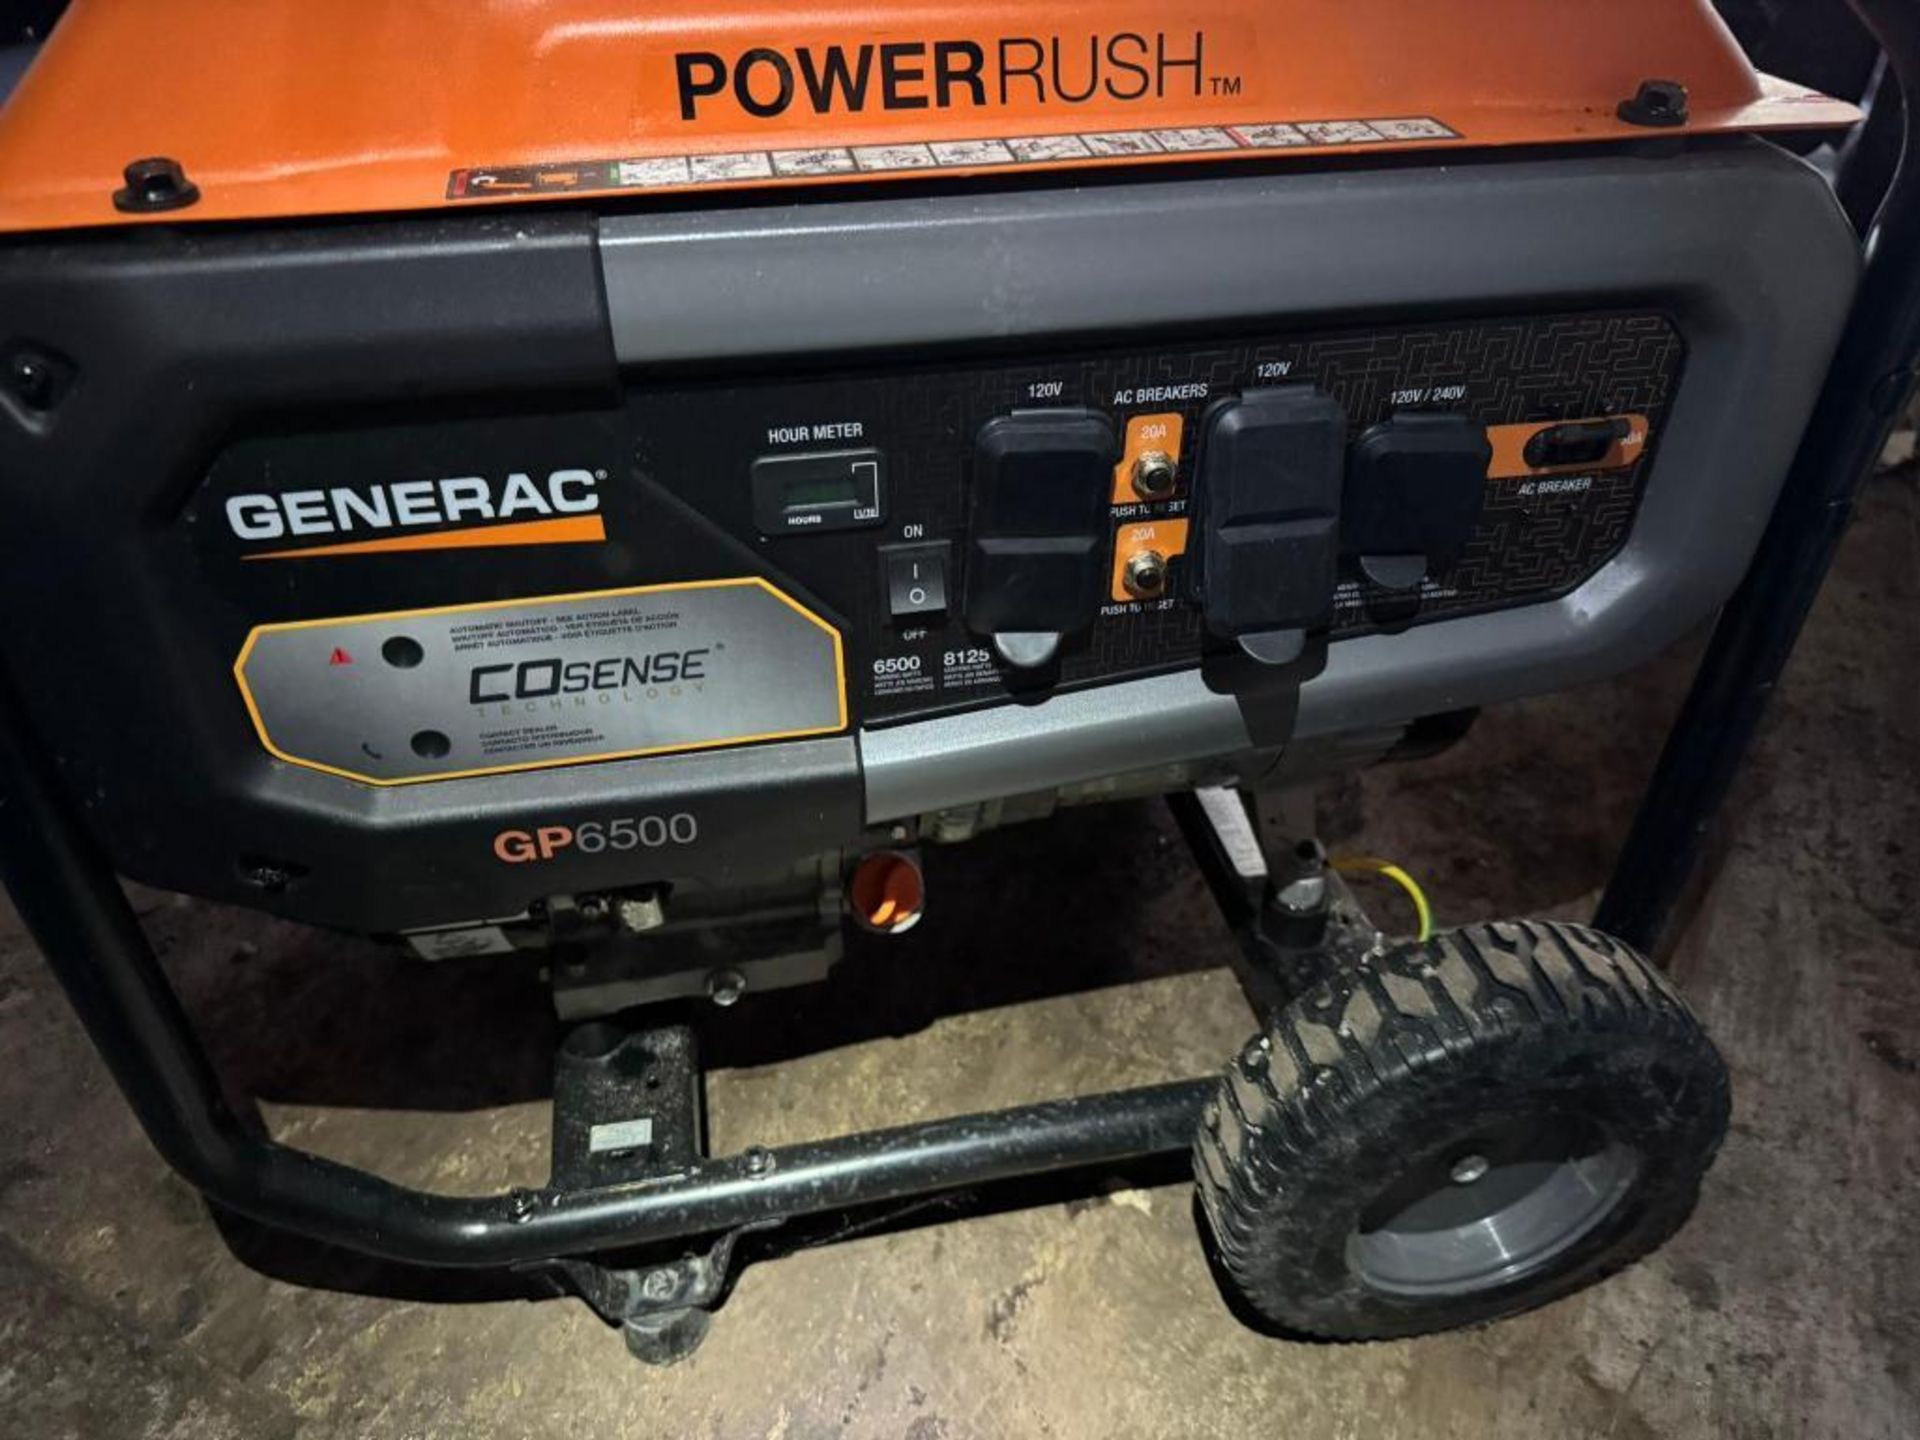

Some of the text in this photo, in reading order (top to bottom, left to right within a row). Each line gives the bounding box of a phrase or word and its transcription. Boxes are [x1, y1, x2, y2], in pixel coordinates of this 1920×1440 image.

[675, 31, 1204, 120] POWERRUSH
[1257, 362, 1291, 379] 120V
[1028, 381, 1063, 398] 120V
[1113, 383, 1209, 405] AC BREAKERS
[1391, 388, 1422, 405] 120V
[1432, 386, 1466, 401] 240V
[768, 422, 863, 443] HOUR METER
[1141, 424, 1166, 439] 20A
[1518, 477, 1592, 495] AC BREAKER
[225, 469, 600, 540] GENERAC
[1110, 505, 1136, 517] PUSH
[788, 514, 822, 525] HOURS
[904, 524, 923, 538] ON
[1100, 605, 1127, 616] PUSH
[903, 627, 928, 641] OFF
[873, 656, 921, 674] 6500
[944, 649, 990, 666] 8125
[470, 649, 710, 704] COSENSE
[476, 683, 705, 717] TECHNOLOGY
[494, 813, 697, 862] GP6500
